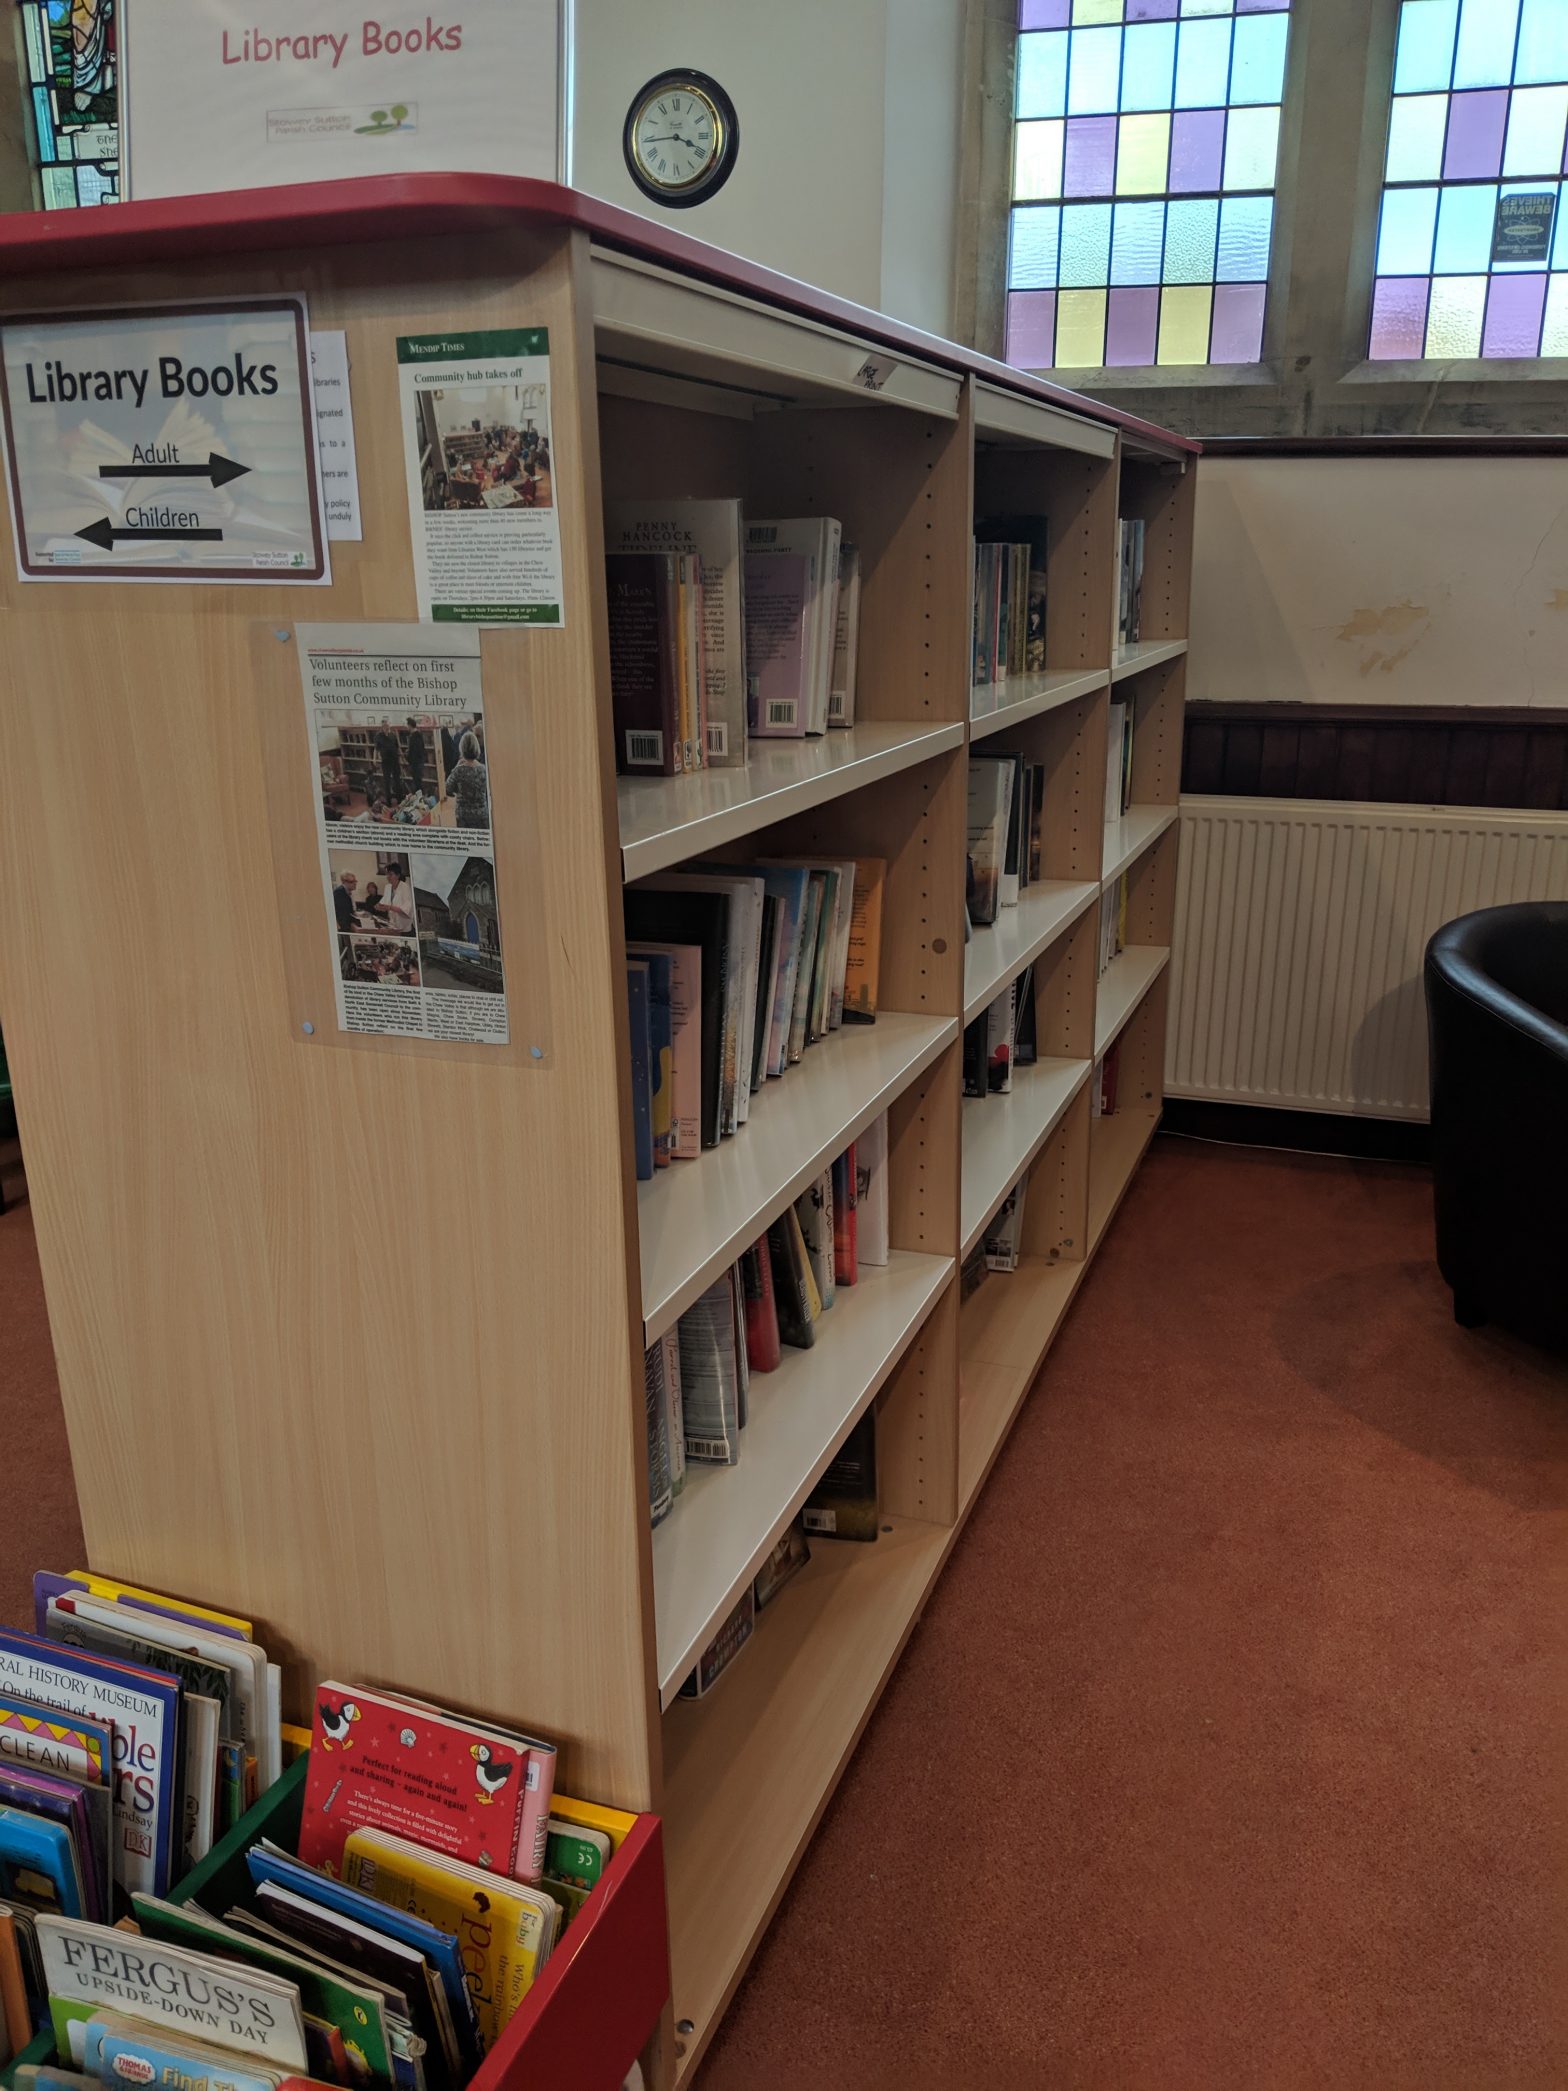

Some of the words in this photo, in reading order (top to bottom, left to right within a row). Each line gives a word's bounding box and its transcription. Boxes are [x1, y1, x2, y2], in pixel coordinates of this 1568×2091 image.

[222, 28, 348, 68] Library
[362, 16, 462, 56] Books
[26, 360, 148, 408] Library
[159, 353, 278, 398] Books
[414, 372, 465, 384] Community
[467, 370, 482, 380] hub
[486, 369, 508, 380] takes
[510, 368, 522, 378] off
[132, 442, 180, 464] Adult
[331, 500, 350, 508] policy
[126, 508, 200, 528] Children
[328, 512, 352, 522] unduly
[636, 522, 677, 532] PENNY
[623, 532, 692, 542] HANCOCK
[310, 658, 370, 671] Volunteers
[373, 659, 410, 672] reflect
[412, 662, 428, 672] on
[431, 660, 455, 672] first
[312, 676, 331, 687] few
[335, 676, 378, 688] months
[381, 676, 393, 688] of
[395, 676, 414, 689] the
[418, 678, 458, 692] Bishop
[313, 692, 350, 704] Sutton
[354, 693, 421, 709] Community
[424, 694, 467, 710] Library
[2, 1680, 21, 1696] On
[25, 1688, 43, 1701] the
[47, 1694, 70, 1713] trail
[73, 1705, 86, 1716] of
[28, 1664, 89, 1695] HISTORY
[93, 1684, 158, 1718] MUSEUM
[0, 1735, 70, 1772] CLEAN
[362, 1755, 389, 1771] Perfect
[391, 1764, 402, 1776] for
[404, 1770, 434, 1788] reading
[435, 1781, 458, 1795] aloud
[350, 1766, 365, 1776] and
[366, 1770, 395, 1788] sharing
[404, 1784, 424, 1797] again
[426, 1791, 441, 1802] and
[443, 1798, 468, 1812] again!
[347, 1799, 358, 1807] and
[512, 1788, 525, 1842] PUFFIN
[532, 1814, 549, 1870] FAIRY
[516, 1912, 530, 1945] baby
[500, 1954, 510, 1974] the
[58, 1936, 275, 2028] FERGUS'S
[510, 1963, 524, 2000] Who's
[76, 1972, 220, 2028] UPSIDE-DOWN
[229, 2018, 269, 2045] DAY
[118, 2056, 151, 2074] THOMAS
[162, 2066, 208, 2091] Find
